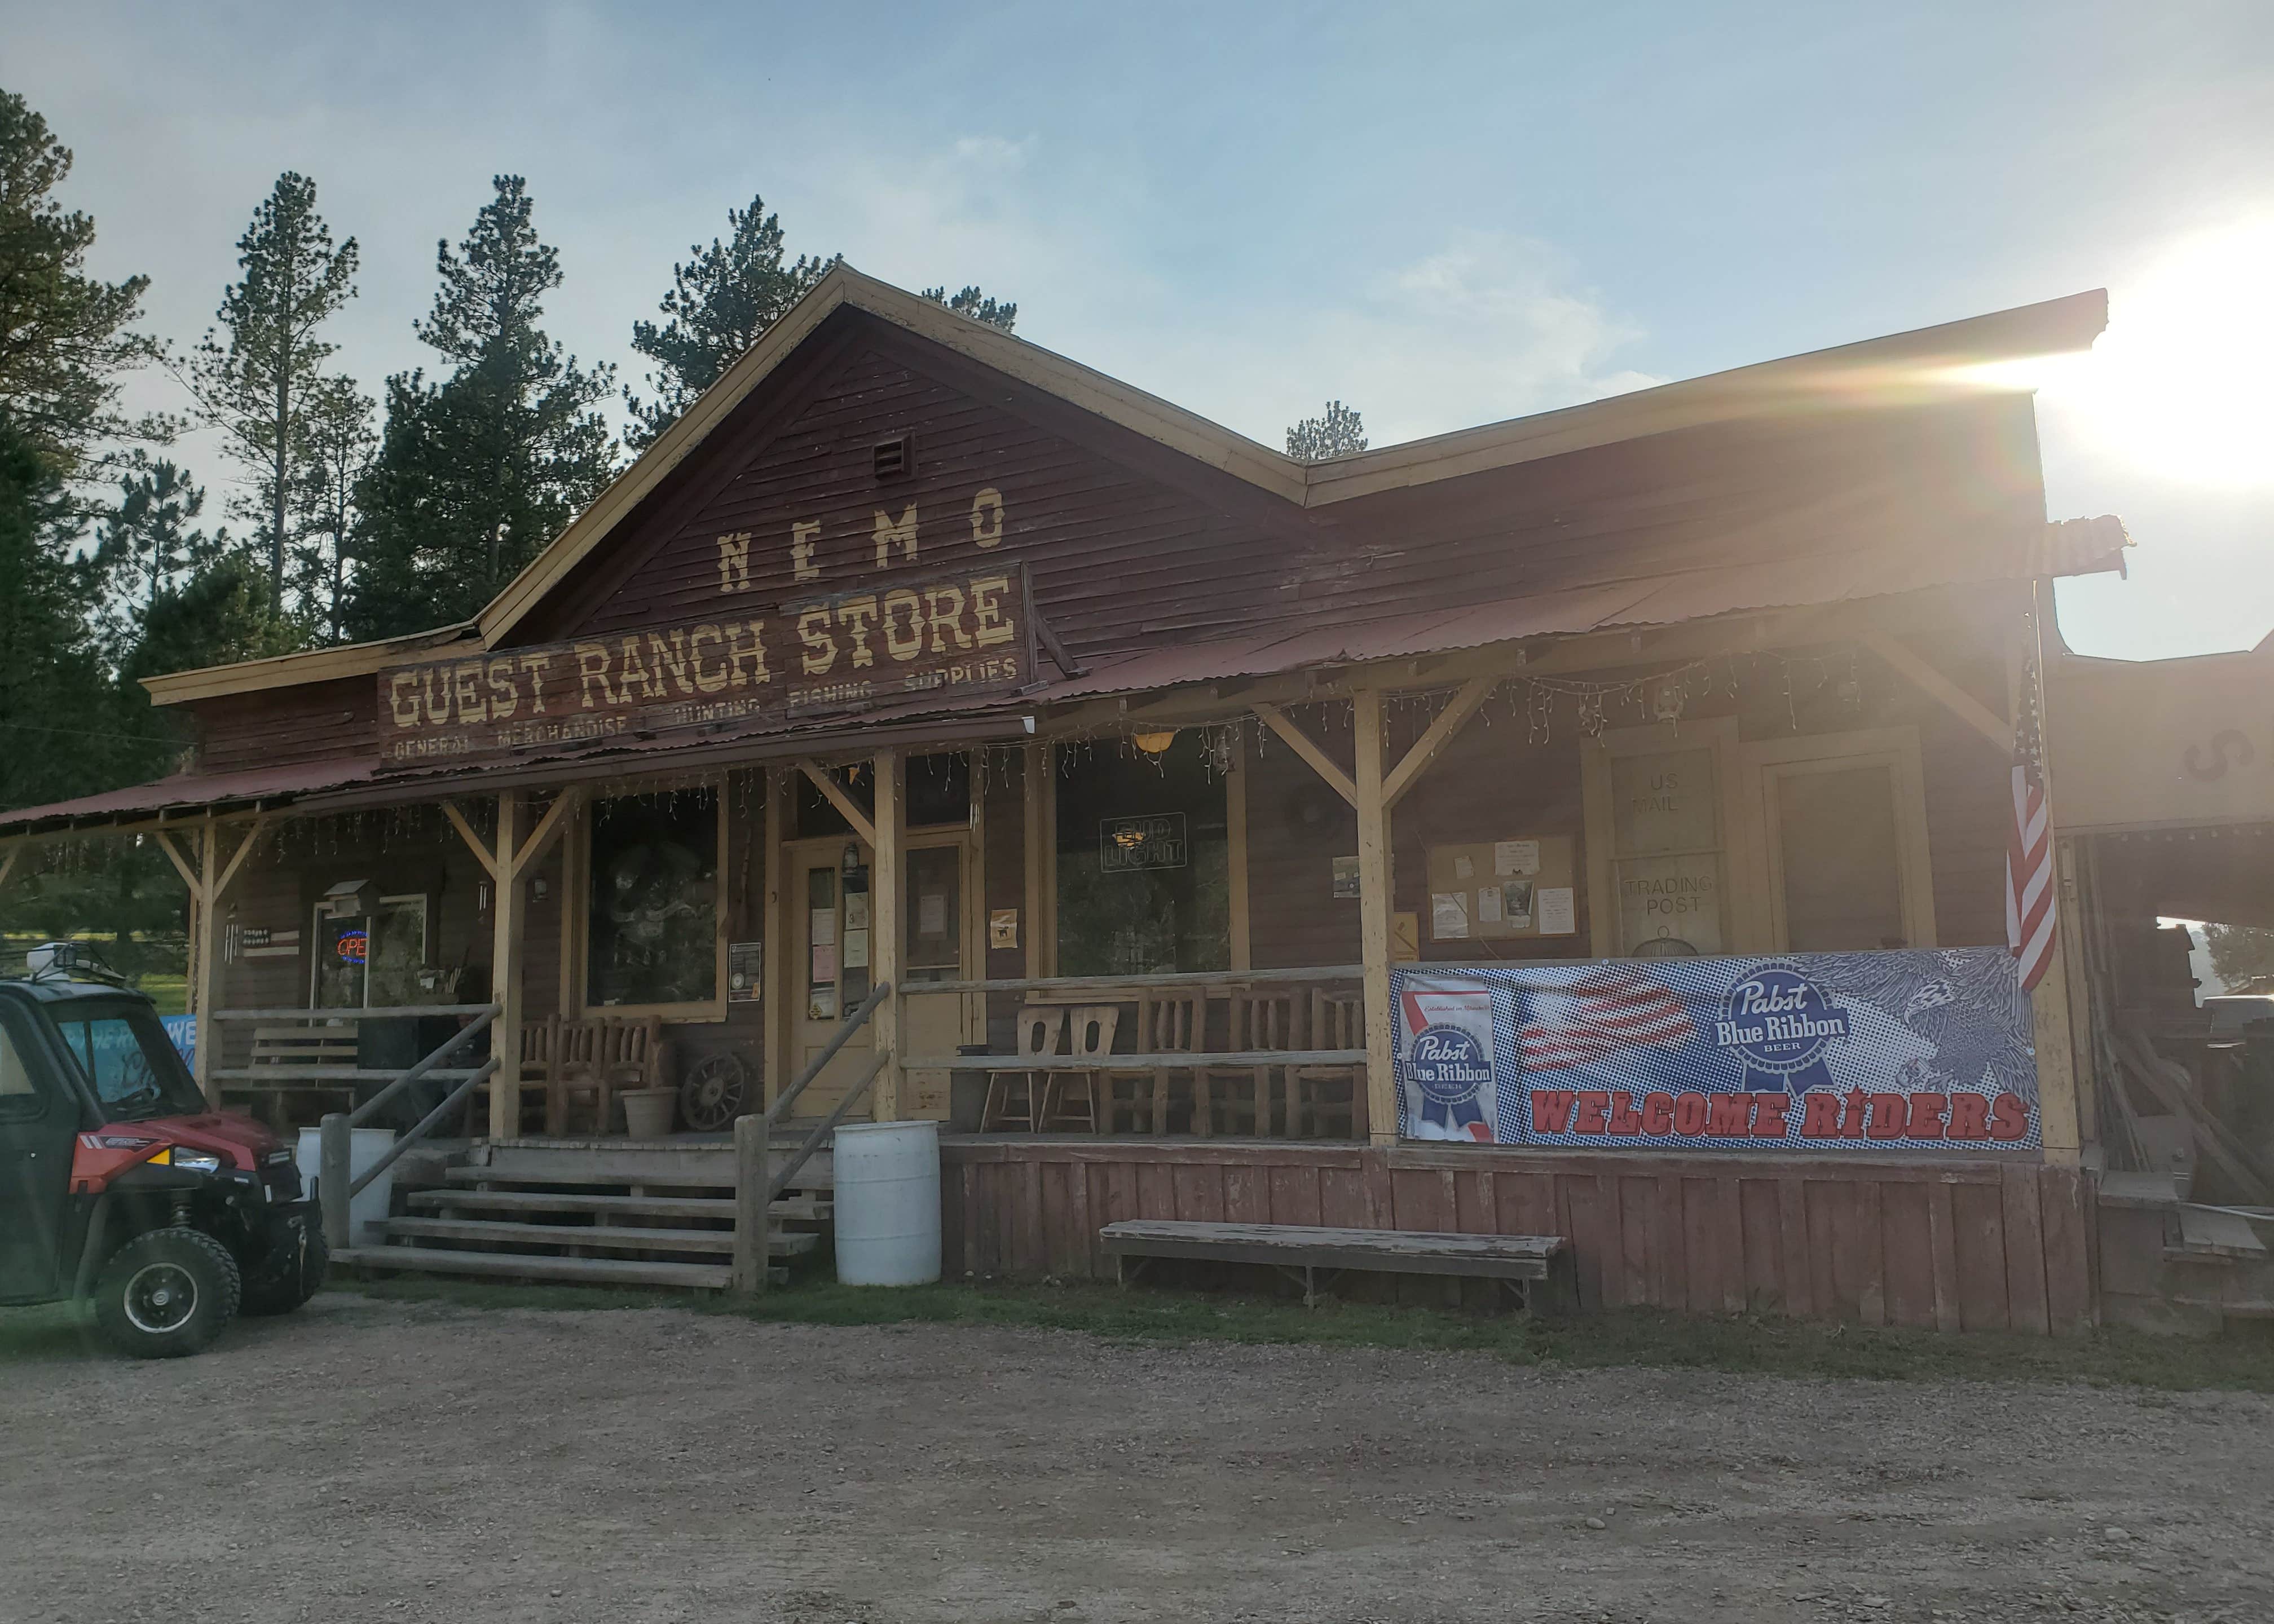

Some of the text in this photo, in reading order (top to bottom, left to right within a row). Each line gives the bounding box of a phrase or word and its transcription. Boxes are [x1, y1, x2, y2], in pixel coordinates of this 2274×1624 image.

[716, 487, 1006, 594] NEMO
[389, 576, 1016, 727] GUEST RANCH STORE
[790, 679, 873, 708] FISHING
[904, 657, 1017, 689] SUPPLIES
[1651, 773, 1678, 790] US
[1632, 796, 1679, 813] MAIL
[1105, 839, 1183, 867] LIGHT
[1624, 876, 1713, 895] TRADING
[1647, 896, 1702, 916] POST
[337, 938, 369, 956] OPE
[1736, 981, 1808, 1016] Pabst
[1715, 1014, 1845, 1046] Blue Ribbon
[1420, 1035, 1470, 1061] Pabst
[1764, 1043, 1801, 1053] BEER
[1406, 1062, 1491, 1082] Blue Ribbon
[1531, 1089, 1789, 1138] WELCOME
